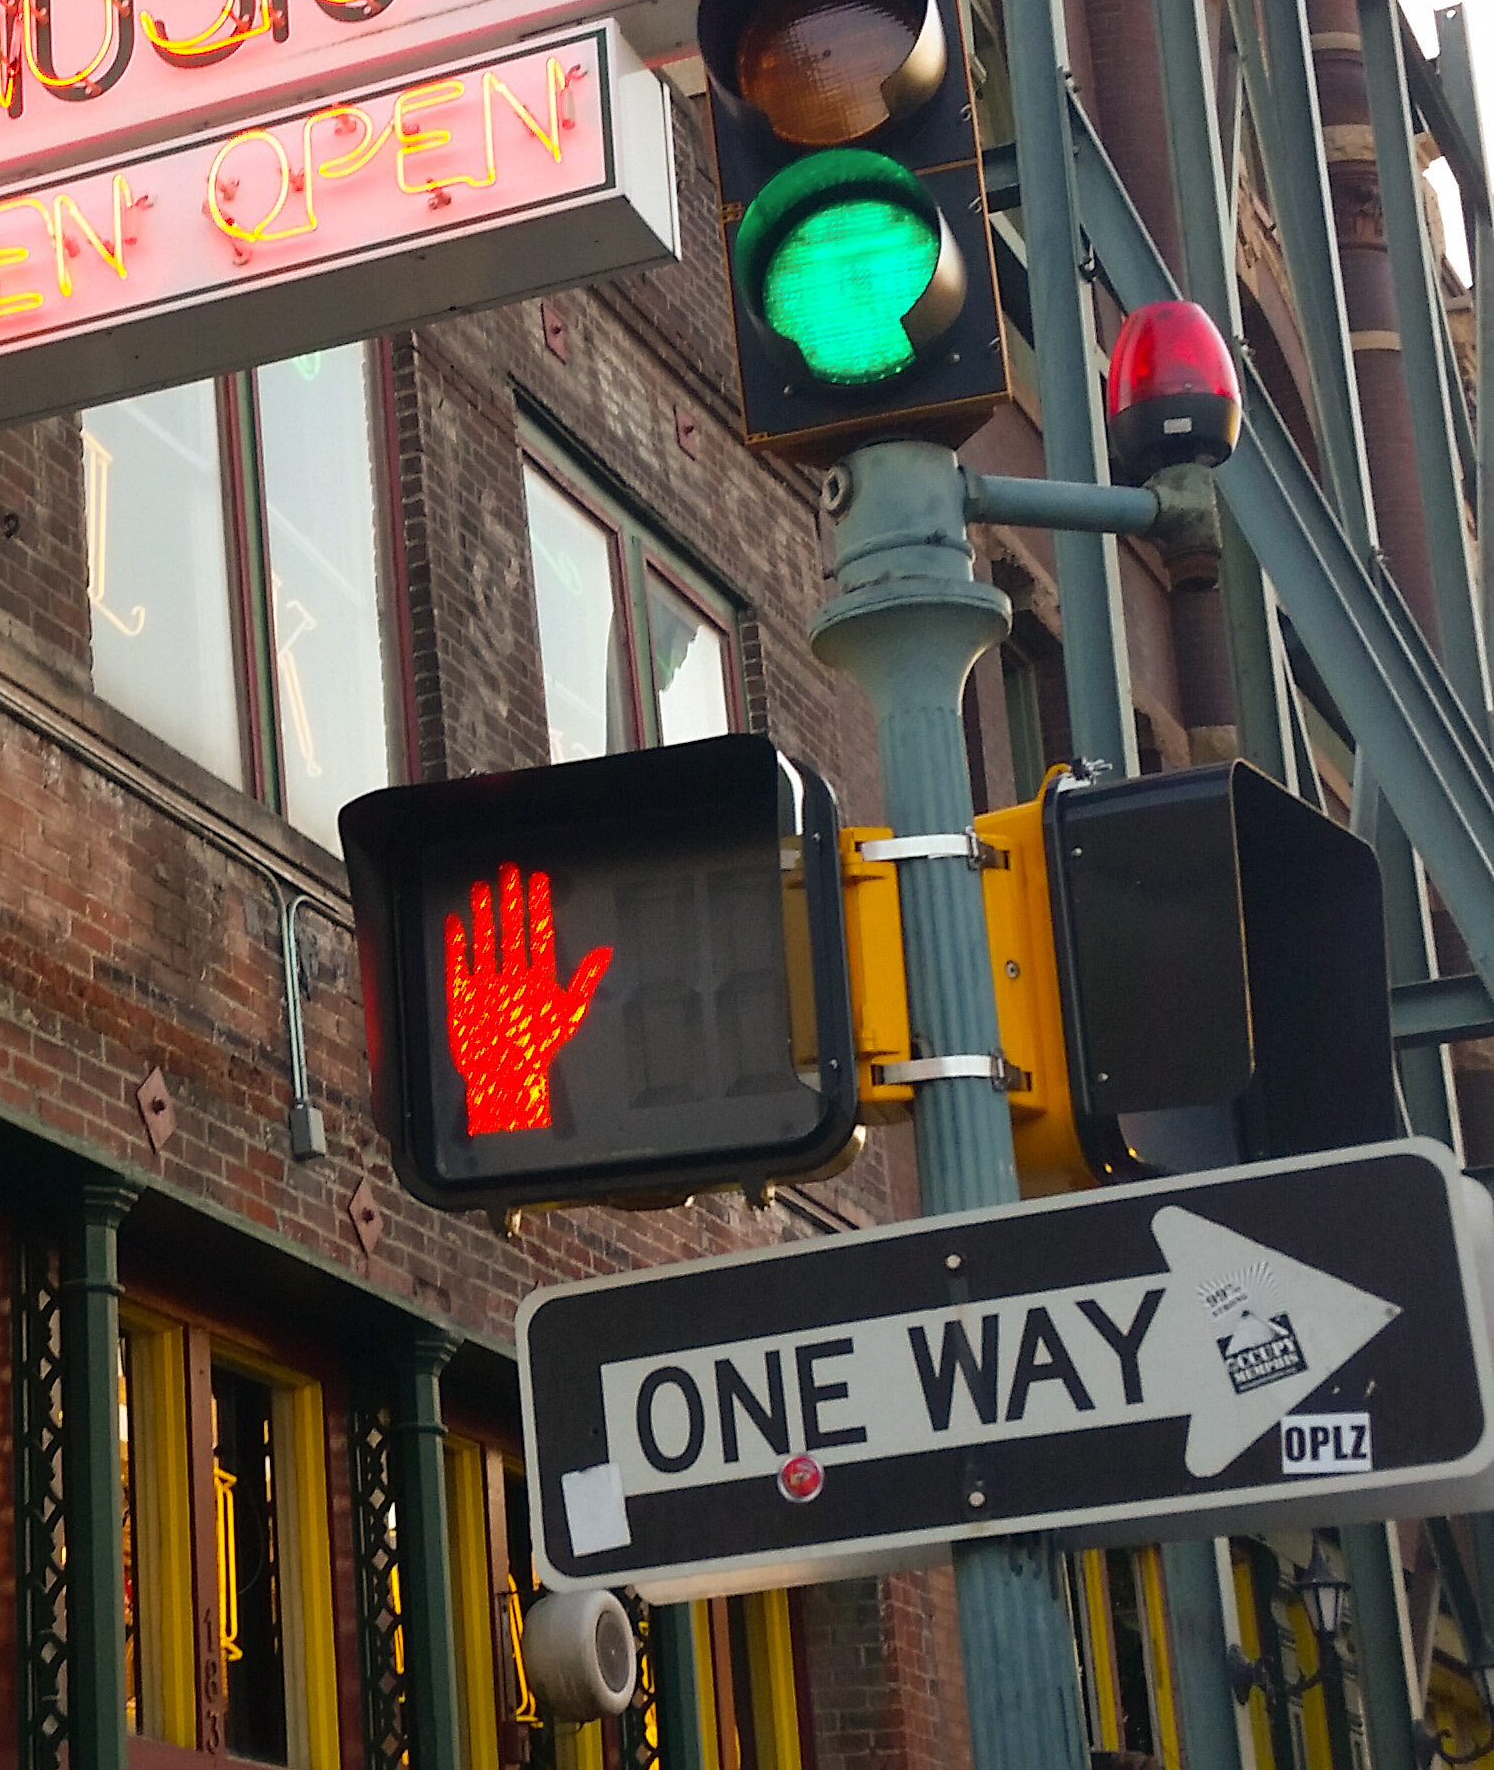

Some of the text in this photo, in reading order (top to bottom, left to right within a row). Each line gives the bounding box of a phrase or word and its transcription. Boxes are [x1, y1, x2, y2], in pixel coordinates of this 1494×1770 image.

[208, 54, 574, 243] OPEN
[1225, 1336, 1296, 1374] OCCUPY
[1234, 1354, 1300, 1383] MEMPHIS
[635, 1286, 1168, 1472] ONE WAY
[1284, 1425, 1367, 1462] OPLZ
